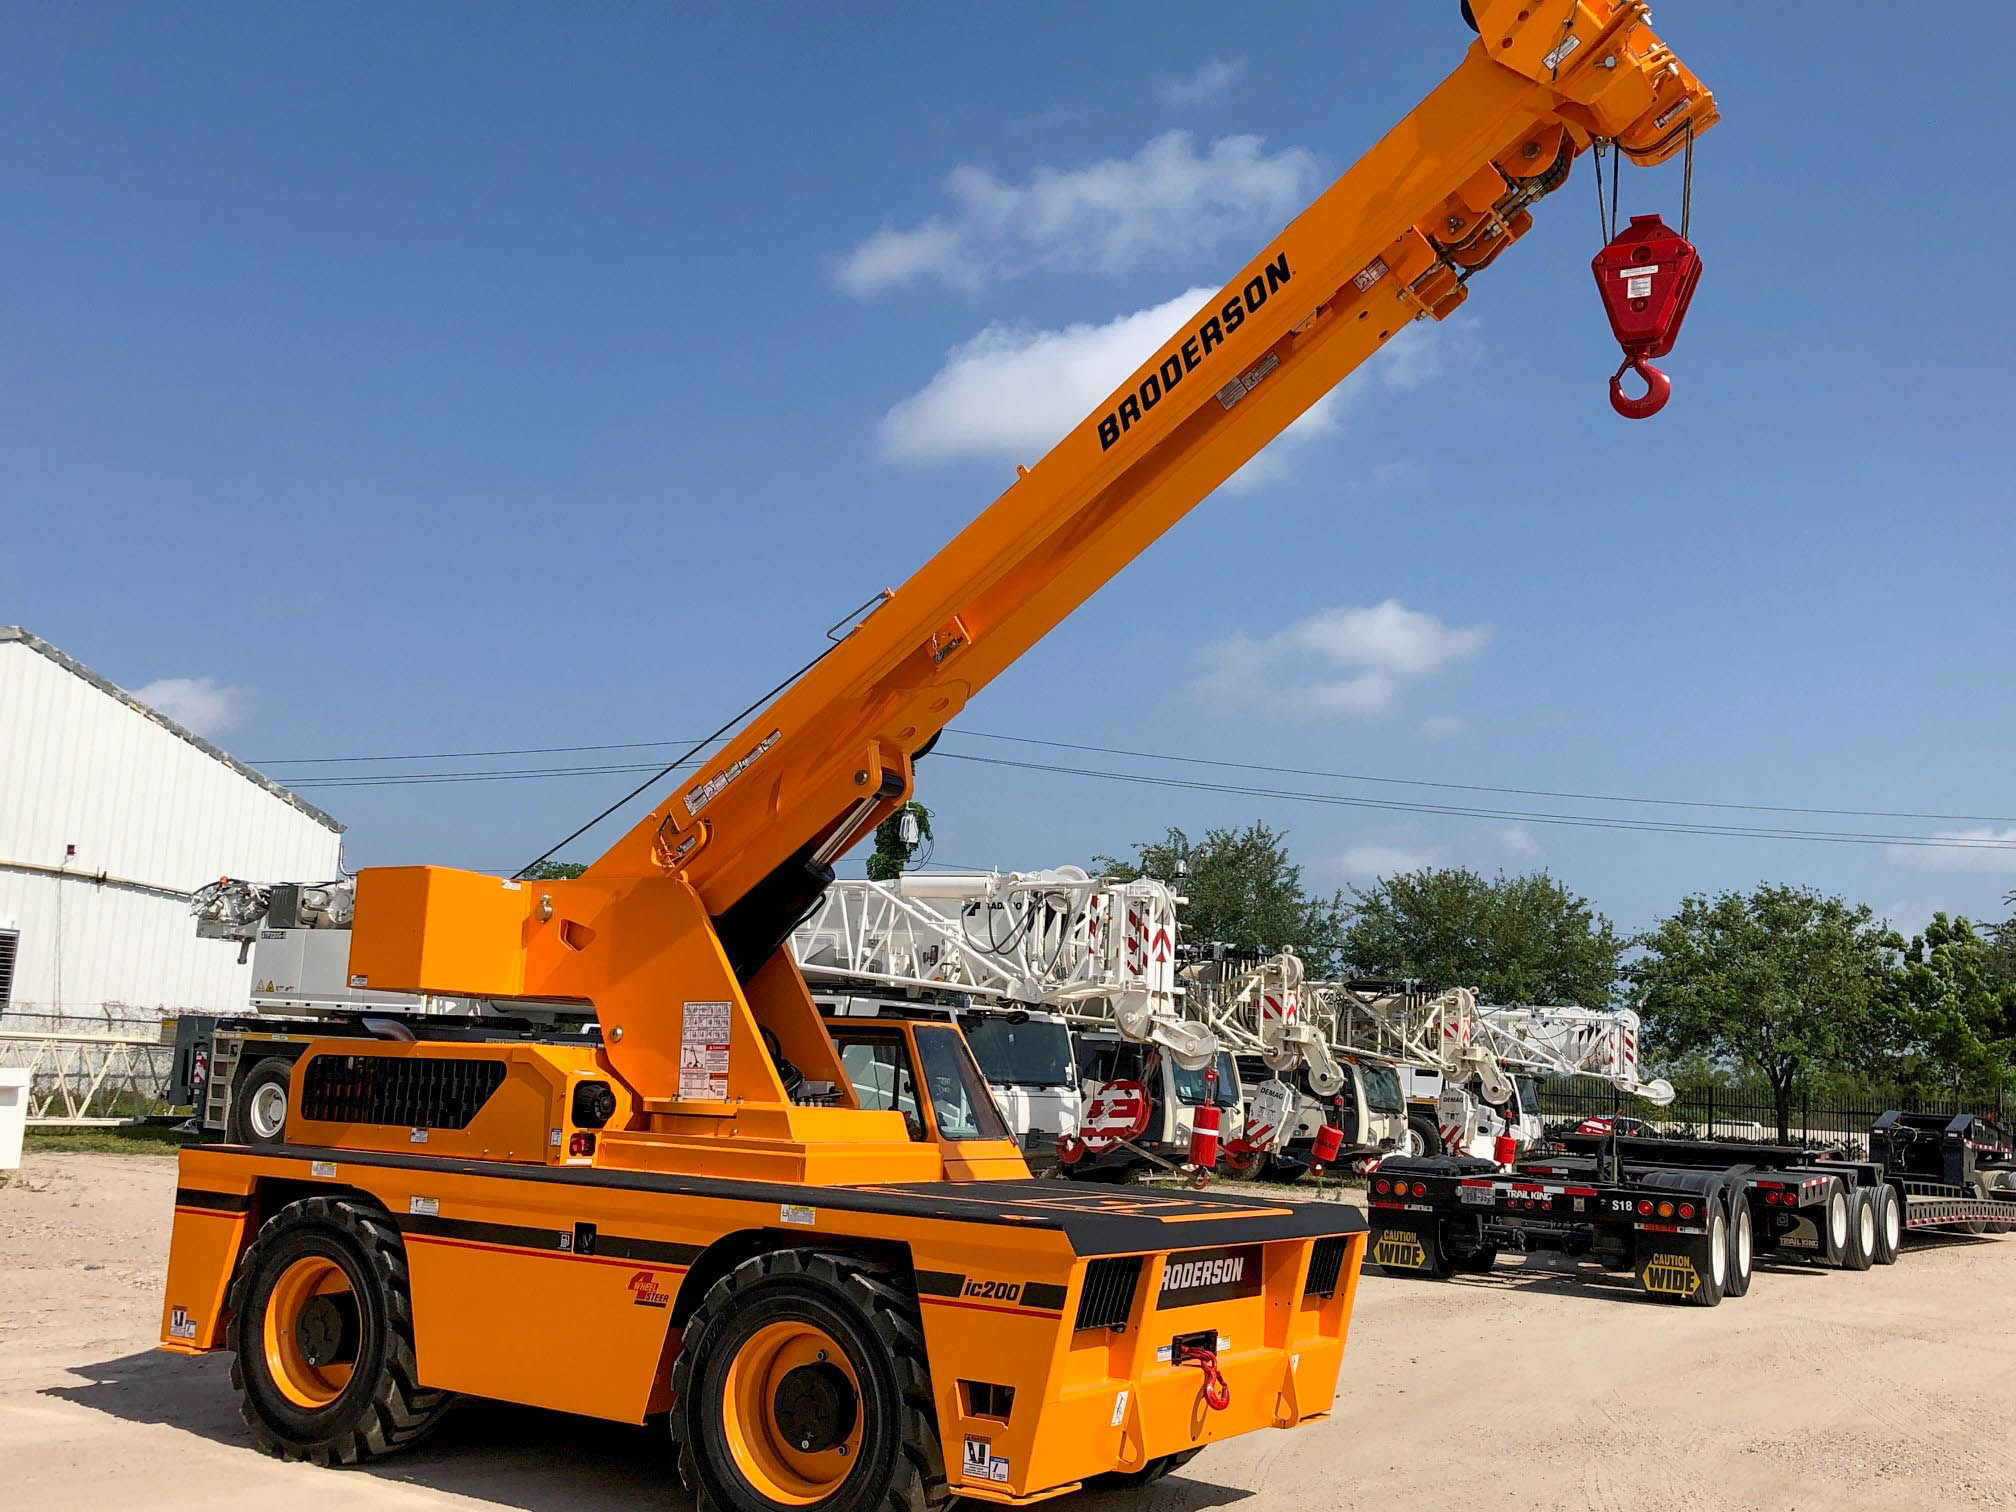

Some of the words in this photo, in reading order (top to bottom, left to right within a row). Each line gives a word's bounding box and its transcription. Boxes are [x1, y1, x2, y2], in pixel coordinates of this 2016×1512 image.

[1097, 251, 1293, 452] BRODERSON
[986, 901, 1023, 910] TADO
[1260, 1087, 1284, 1100] DEMAG
[1506, 1189, 1530, 1199] TRAIL
[1531, 1190, 1552, 1201] KING
[1612, 1200, 1633, 1211] S18
[1383, 1229, 1417, 1243] CAUTION
[1379, 1241, 1421, 1267] WIDE
[1653, 1252, 1690, 1268] CAUTION
[1160, 1257, 1244, 1291] RODERSON
[1648, 1266, 1695, 1292] WIDE
[628, 1271, 655, 1300] 4
[634, 1281, 658, 1292] WHEEL
[964, 1278, 1021, 1301] ic200
[646, 1292, 670, 1303] STEER
